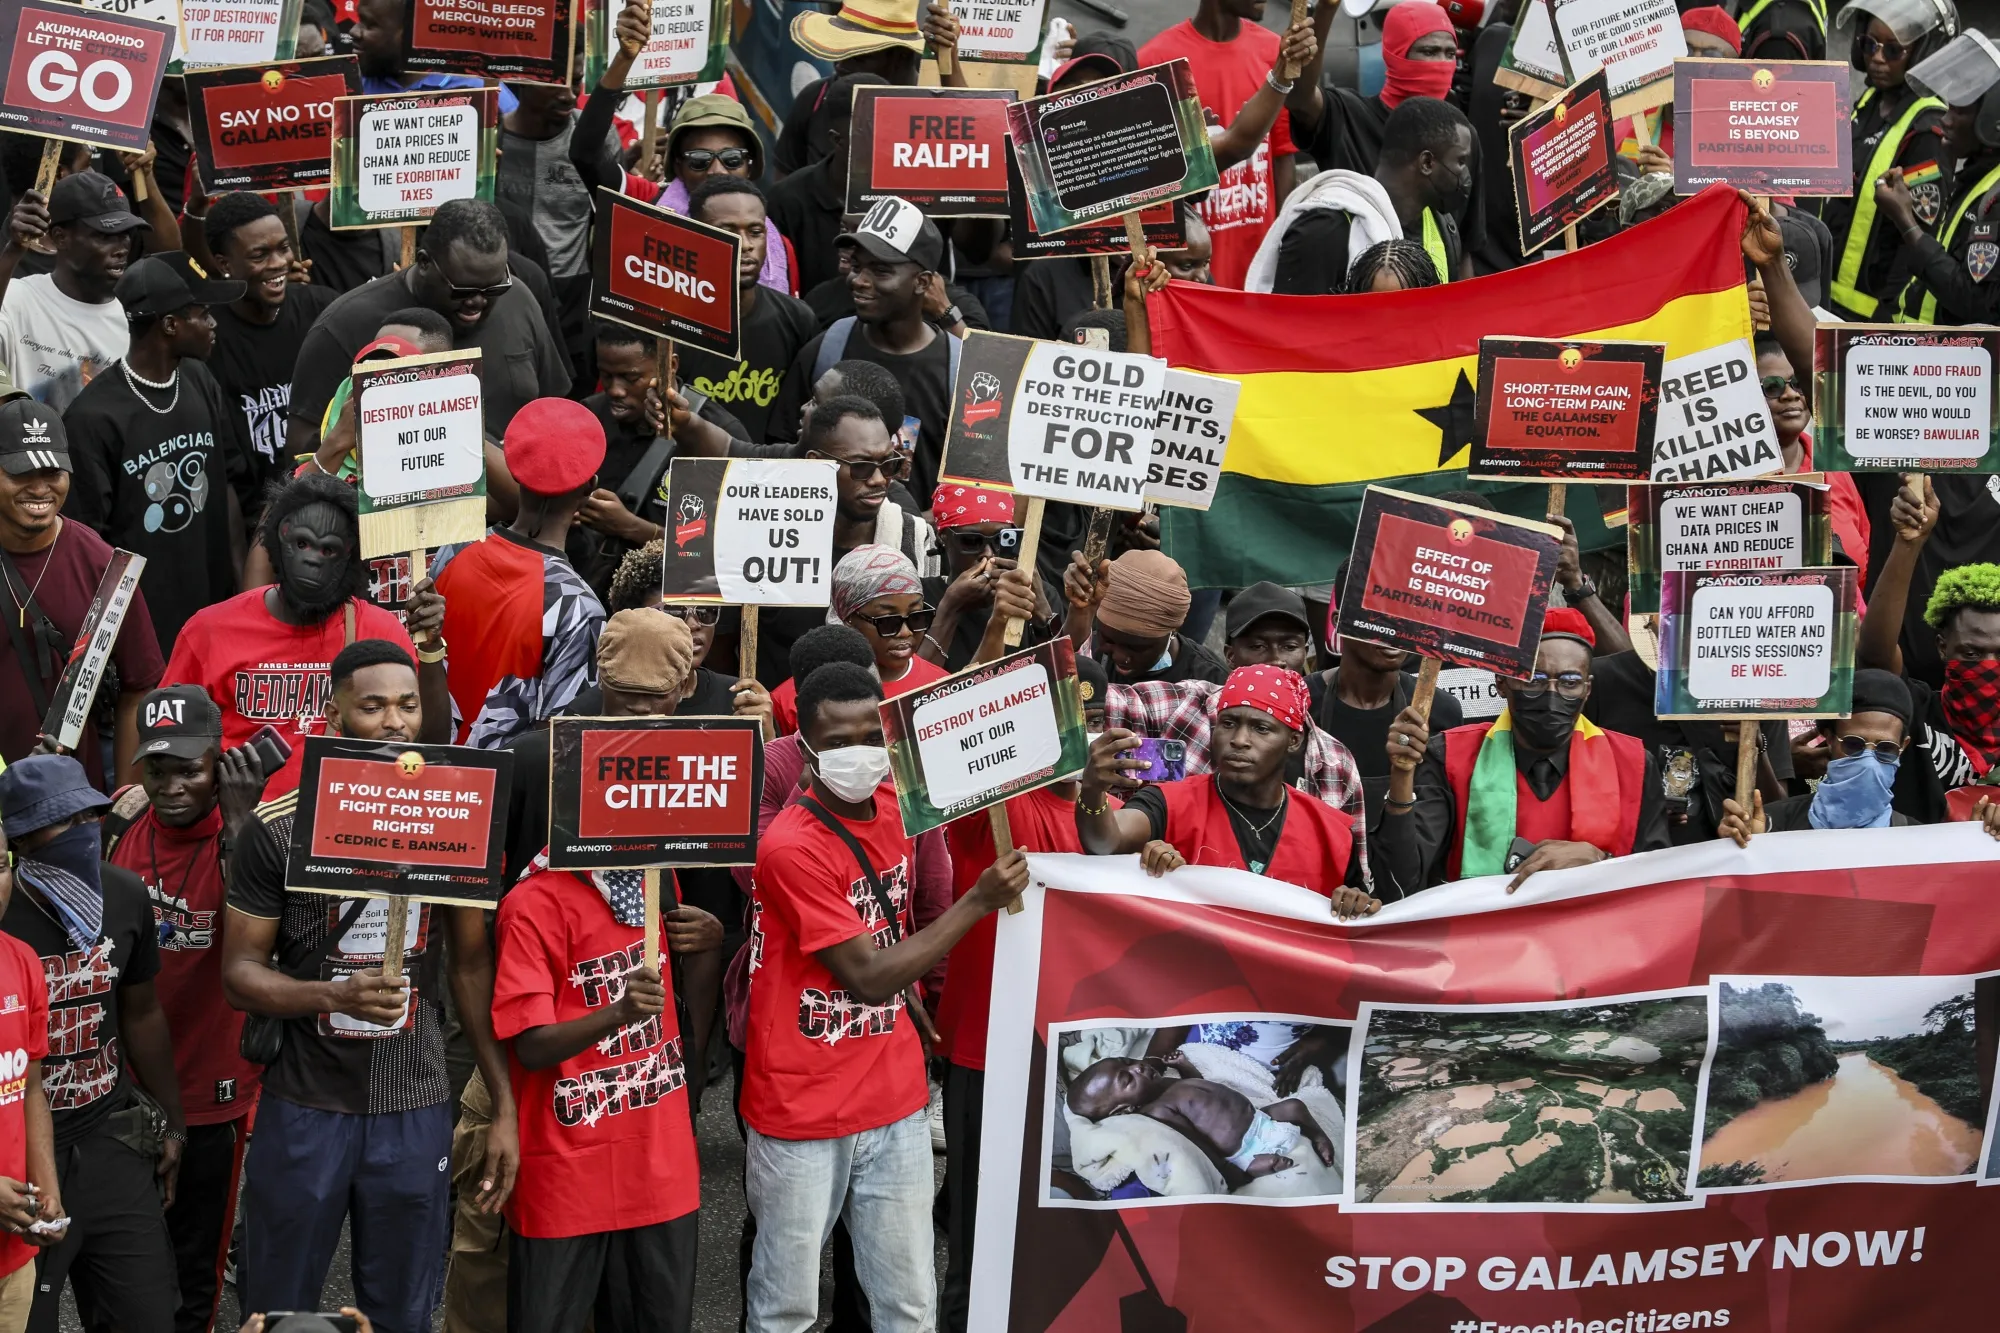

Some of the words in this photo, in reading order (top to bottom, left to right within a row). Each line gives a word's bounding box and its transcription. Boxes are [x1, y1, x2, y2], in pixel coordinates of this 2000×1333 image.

[184, 8, 210, 22] STOP
[214, 10, 277, 24] DESTROYING
[433, 10, 502, 28] MERCURY;
[505, 18, 535, 28] OUR
[492, 4, 545, 16] BLEEDS
[953, 7, 968, 19] ON
[973, 8, 993, 20] THE
[997, 10, 1022, 22] LINE
[429, 24, 476, 36] CROPS
[480, 29, 537, 42] WITHER.
[960, 26, 983, 36] NANA
[987, 28, 1013, 38] ADDO
[1567, 39, 1582, 52] LET
[1585, 34, 1595, 46] US
[1598, 30, 1608, 42] BE
[1610, 23, 1631, 37] GOOD
[1633, 5, 1676, 28] STEWARDS
[1572, 26, 1589, 37] OUR
[1590, 14, 1621, 32] FUTURE
[35, 21, 144, 49] AKUPHARAOHDO
[192, 29, 201, 40] IT
[204, 29, 224, 42] FOR
[228, 30, 265, 43] PROFIT
[1589, 48, 1599, 58] OF
[1601, 41, 1618, 54] OUR
[1619, 32, 1645, 46] LANDS
[1647, 24, 1663, 36] AND
[27, 32, 54, 48] LET
[55, 36, 82, 51] THE
[86, 42, 148, 63] CITIZENS
[1601, 51, 1628, 66] WATER
[1630, 40, 1658, 56] BODIES
[27, 50, 132, 113] GO
[220, 109, 258, 128] SAY
[267, 106, 300, 123] NO
[308, 102, 333, 119] TO
[1729, 101, 1777, 112] EFFECT
[1780, 102, 1798, 112] OF
[372, 119, 390, 131] WE
[395, 116, 424, 129] WANT
[428, 114, 463, 127] CHEAP
[909, 115, 975, 140] FREE
[1729, 115, 1799, 126] GALAMSEY
[376, 137, 401, 149] DATA
[405, 134, 444, 147] PRICES
[448, 133, 458, 145] IN
[1532, 144, 1546, 157] YOUR
[1547, 130, 1566, 150] SILENCE
[1567, 119, 1584, 135] MEANS
[1584, 111, 1595, 123] YOU
[1729, 129, 1741, 140] IS
[1745, 129, 1799, 140] BEYOND
[893, 143, 989, 168] RALPH
[1698, 143, 1764, 154] PARTISAN
[1768, 143, 1830, 155] POLITICS.
[363, 155, 399, 168] GHANA
[404, 153, 424, 165] AND
[429, 149, 470, 163] REDUCE
[373, 174, 392, 185] THE
[396, 168, 460, 184] EXORBITANT
[400, 189, 433, 201] TAXES
[643, 235, 698, 274] FREE
[624, 255, 715, 303] CEDRIC
[20, 335, 56, 354] Everyone
[58, 349, 74, 359] who
[1850, 336, 1984, 347] #SAYNOTOGALAMSEY
[1053, 355, 1144, 388] GOLD
[1856, 364, 1874, 375] WE
[1878, 365, 1908, 376] THINK
[1913, 365, 1941, 376] ADDO
[1946, 366, 1981, 376] FRAUD
[1024, 380, 1065, 399] FOR
[1072, 386, 1111, 406] THE
[1119, 393, 1161, 411] FEW
[1504, 383, 1591, 396] SHORT-TERM
[1595, 385, 1631, 399] GAIN,
[1861, 386, 1870, 396] IS
[1875, 386, 1895, 397] THE
[1899, 386, 1932, 399] DEVIL,
[1937, 387, 1950, 397] DO
[1955, 387, 1976, 398] YOU
[364, 405, 414, 424] DESTROY
[419, 396, 479, 416] GALAMSEY
[1506, 397, 1587, 410] LONG-TERM
[1590, 399, 1626, 411] PAIN:
[1683, 398, 1718, 427] IS
[1865, 407, 1898, 418] KNOW
[1902, 408, 1927, 418] WHO
[1932, 408, 1970, 419] WOULD
[1027, 401, 1156, 430] DESTRUCTION
[1512, 411, 1540, 422] THE
[1543, 412, 1618, 424] GALAMSEY
[23, 434, 51, 444] adidas
[398, 430, 419, 445] NOT
[424, 427, 446, 441] OUR
[1526, 425, 1600, 437] EQUATION.
[1652, 412, 1766, 464] KILLING
[1856, 429, 1870, 439] BE
[1874, 429, 1920, 439] WORSE?
[1924, 429, 1979, 440] BAWULIAR
[1043, 423, 1134, 465] FOR
[401, 453, 445, 471] FUTURE
[1020, 463, 1069, 485] THE
[1077, 471, 1146, 495] MANY
[727, 486, 759, 498] OUR
[765, 487, 833, 502] LEADERS,
[738, 508, 779, 521] HAVE
[784, 509, 824, 521] SOLD
[769, 529, 799, 548] US
[743, 557, 820, 583] OUT!
[1710, 607, 1733, 620] CAN
[1739, 607, 1763, 619] YOU
[1767, 606, 1814, 619] AFFORD
[1697, 626, 1751, 639] BOTTLED
[1756, 625, 1796, 638] WATER
[1801, 625, 1825, 638] AND
[1698, 645, 1751, 658] DIALYSIS
[1755, 645, 1822, 658] SESSIONS?
[1731, 664, 1748, 677] BE
[1752, 664, 1787, 677] WISE.
[146, 700, 185, 727] CAT
[918, 709, 975, 742] DESTROY
[979, 682, 1048, 718] GALAMSEY
[960, 732, 985, 752] NOT
[989, 720, 1015, 741] OUR
[598, 756, 670, 781] FREE
[677, 755, 737, 780] THE
[968, 745, 1017, 775] FUTURE
[330, 782, 344, 794] IF
[348, 783, 382, 797] YOU
[386, 787, 419, 800] CAN
[423, 790, 451, 802] SEE
[455, 792, 482, 805] ME,
[605, 783, 727, 809] CITIZEN
[339, 800, 387, 814] FIGHT
[390, 804, 422, 817] FOR
[427, 807, 469, 820] YOUR
[373, 820, 434, 834] RIGHTS!
[334, 834, 388, 848] CEDRIC
[392, 839, 404, 850] E.
[408, 840, 467, 853] BANSAH
[352, 931, 378, 940] crops
[1325, 1255, 1466, 1291] STOP
[1477, 1238, 1764, 1292] GALAMSEY
[1772, 1226, 1925, 1270] NOW!
